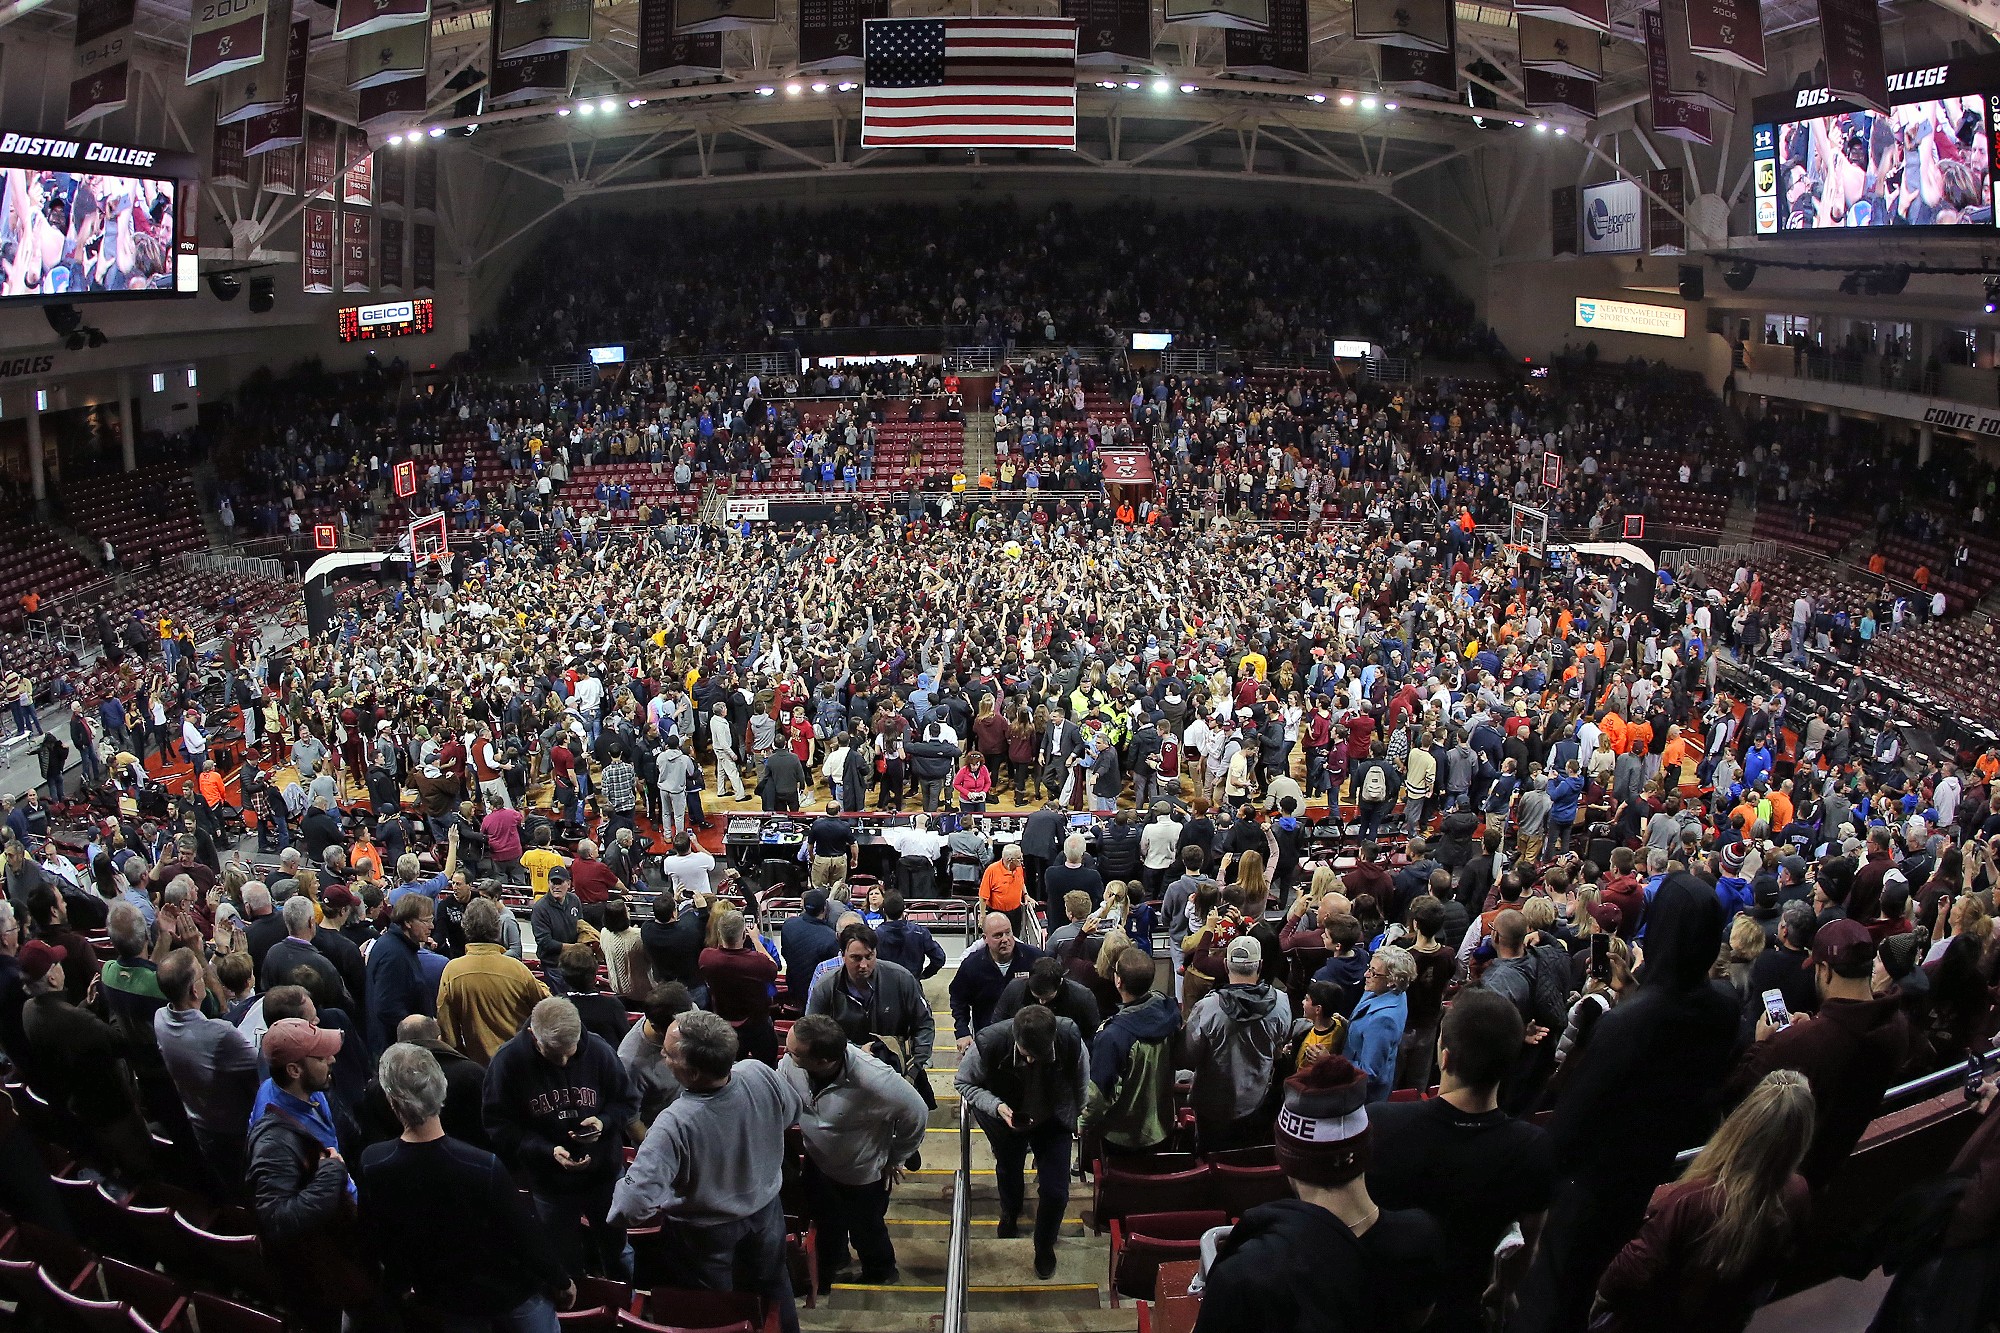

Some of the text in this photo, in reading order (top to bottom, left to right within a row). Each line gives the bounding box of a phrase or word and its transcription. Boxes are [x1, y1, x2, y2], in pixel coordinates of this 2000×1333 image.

[201, 0, 257, 21] 200
[1712, 5, 1738, 20] 2006
[79, 39, 123, 68] 1949
[1886, 65, 1949, 92] OLLEGE
[0, 132, 157, 167] BOSTON COLLEGE
[1758, 169, 1774, 190] ups
[1608, 213, 1637, 224] HOCKEY
[1757, 210, 1775, 220] Gulf
[1607, 223, 1624, 234] EAST
[180, 241, 195, 251] enjoy
[351, 246, 363, 259] 16
[362, 307, 410, 321] GEICO
[1599, 304, 1683, 321] NEWTON-WELLESLEY
[1599, 313, 1630, 323] SPORTS
[1631, 317, 1670, 328] MEDICINE
[0, 355, 54, 377] AGLES
[1923, 407, 2000, 436] CONTE FO
[730, 503, 766, 513] ESPN
